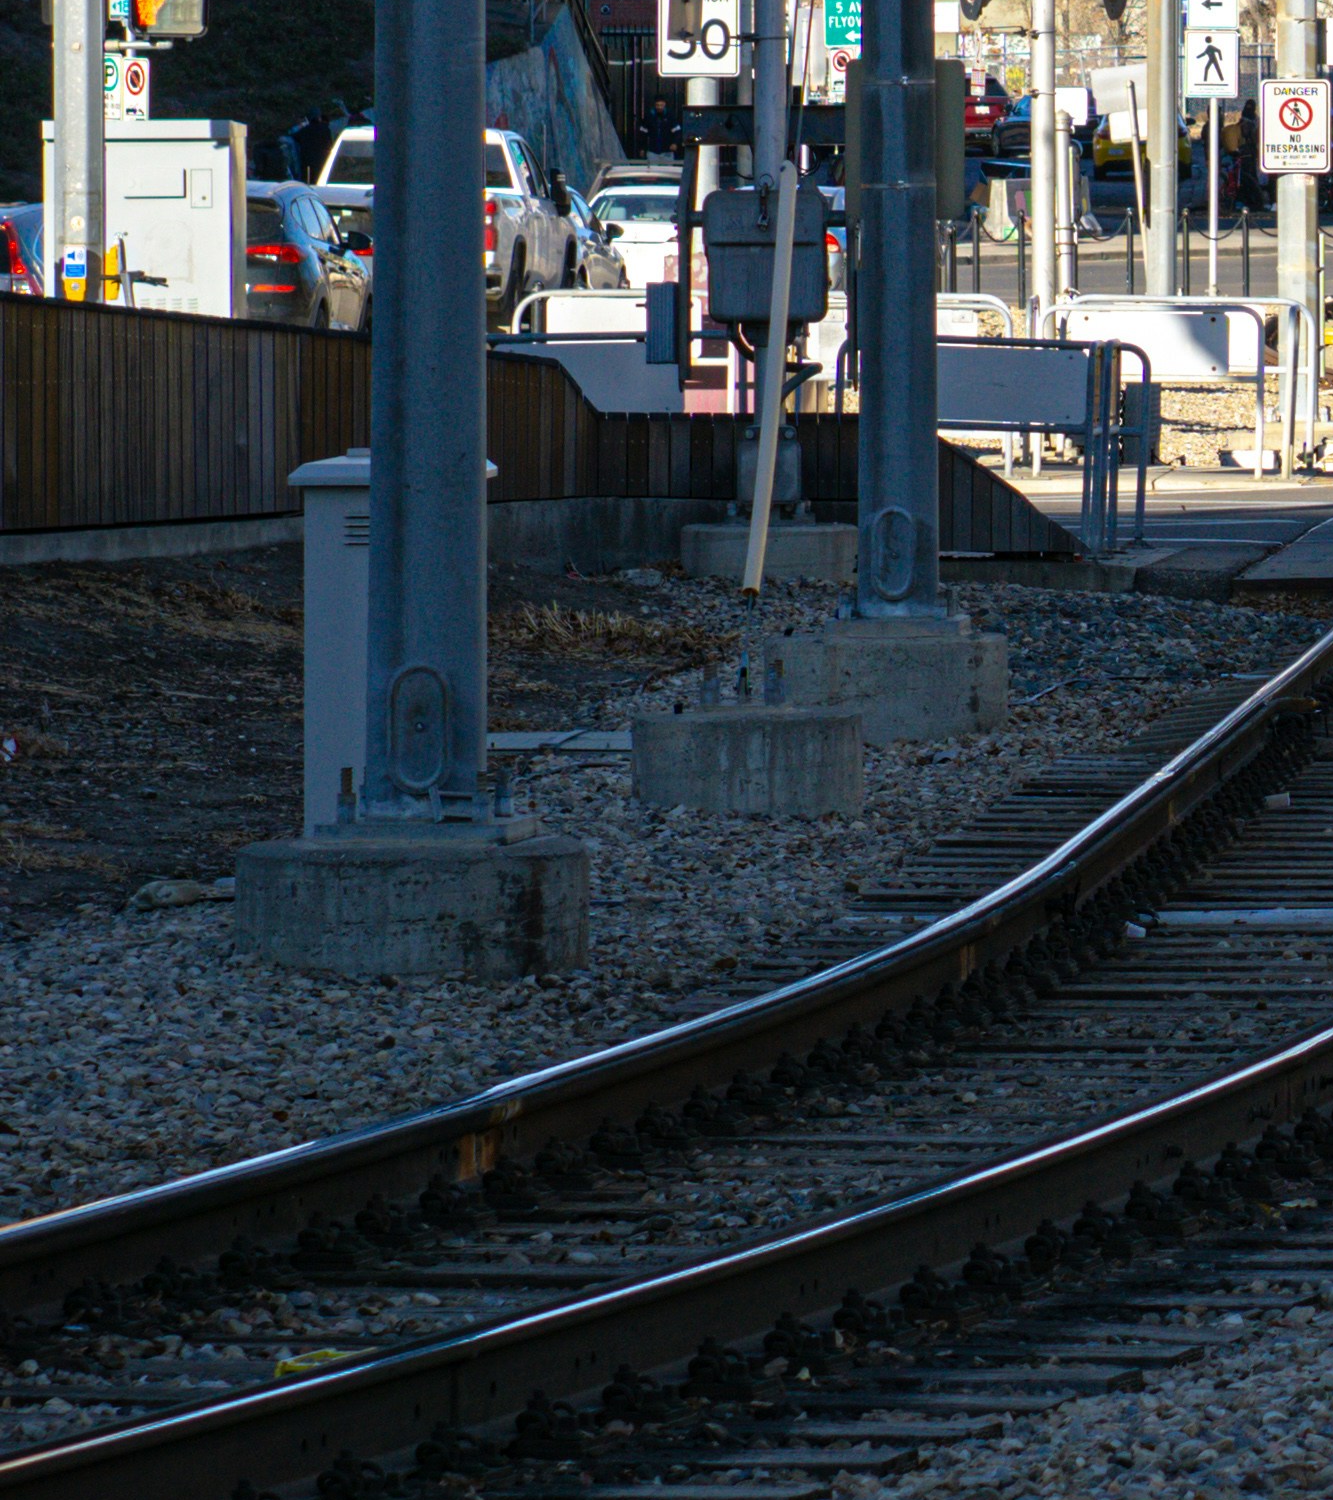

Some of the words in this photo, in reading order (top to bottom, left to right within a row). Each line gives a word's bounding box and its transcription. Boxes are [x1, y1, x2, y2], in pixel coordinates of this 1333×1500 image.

[835, 1, 844, 14] 5
[849, 1, 862, 13] AV
[828, 15, 862, 28] FLYOV
[1273, 87, 1319, 96] DANGER
[1289, 134, 1302, 143] NO
[1266, 144, 1325, 153] TRESPASSING
